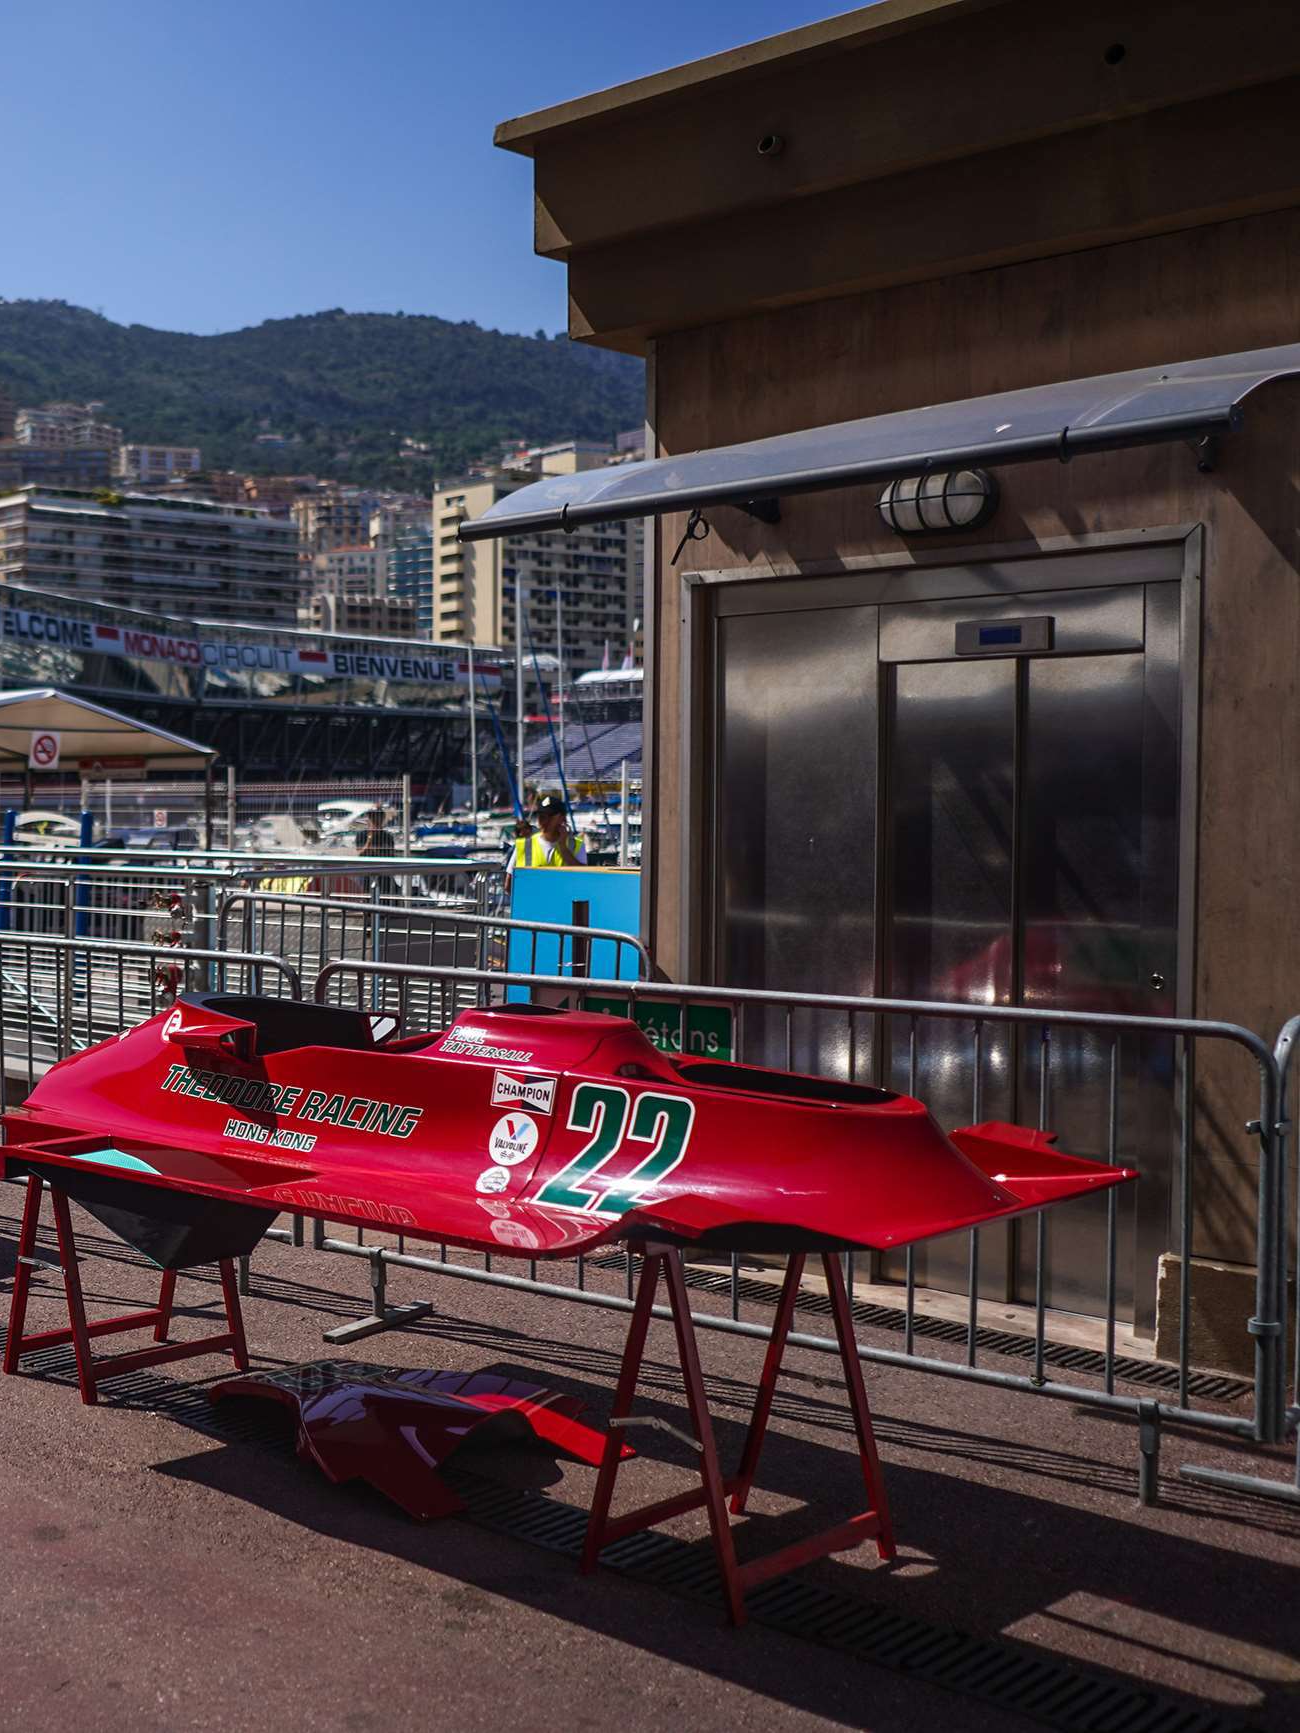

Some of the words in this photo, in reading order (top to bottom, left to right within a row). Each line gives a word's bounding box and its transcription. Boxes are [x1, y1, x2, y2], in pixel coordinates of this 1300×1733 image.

[123, 631, 200, 665] MONACO
[202, 642, 294, 670] CIRCUIT
[334, 653, 456, 682] BIENVENUE
[439, 1040, 533, 1062] TATTERSALL
[161, 1063, 302, 1116] THEODORE
[299, 1090, 424, 1138] RACING
[496, 1082, 551, 1101] CHAMPION
[223, 1118, 270, 1144] HONG
[270, 1128, 317, 1152] KONG
[494, 1136, 529, 1154] VALVOLINE
[530, 1082, 695, 1221] 22
